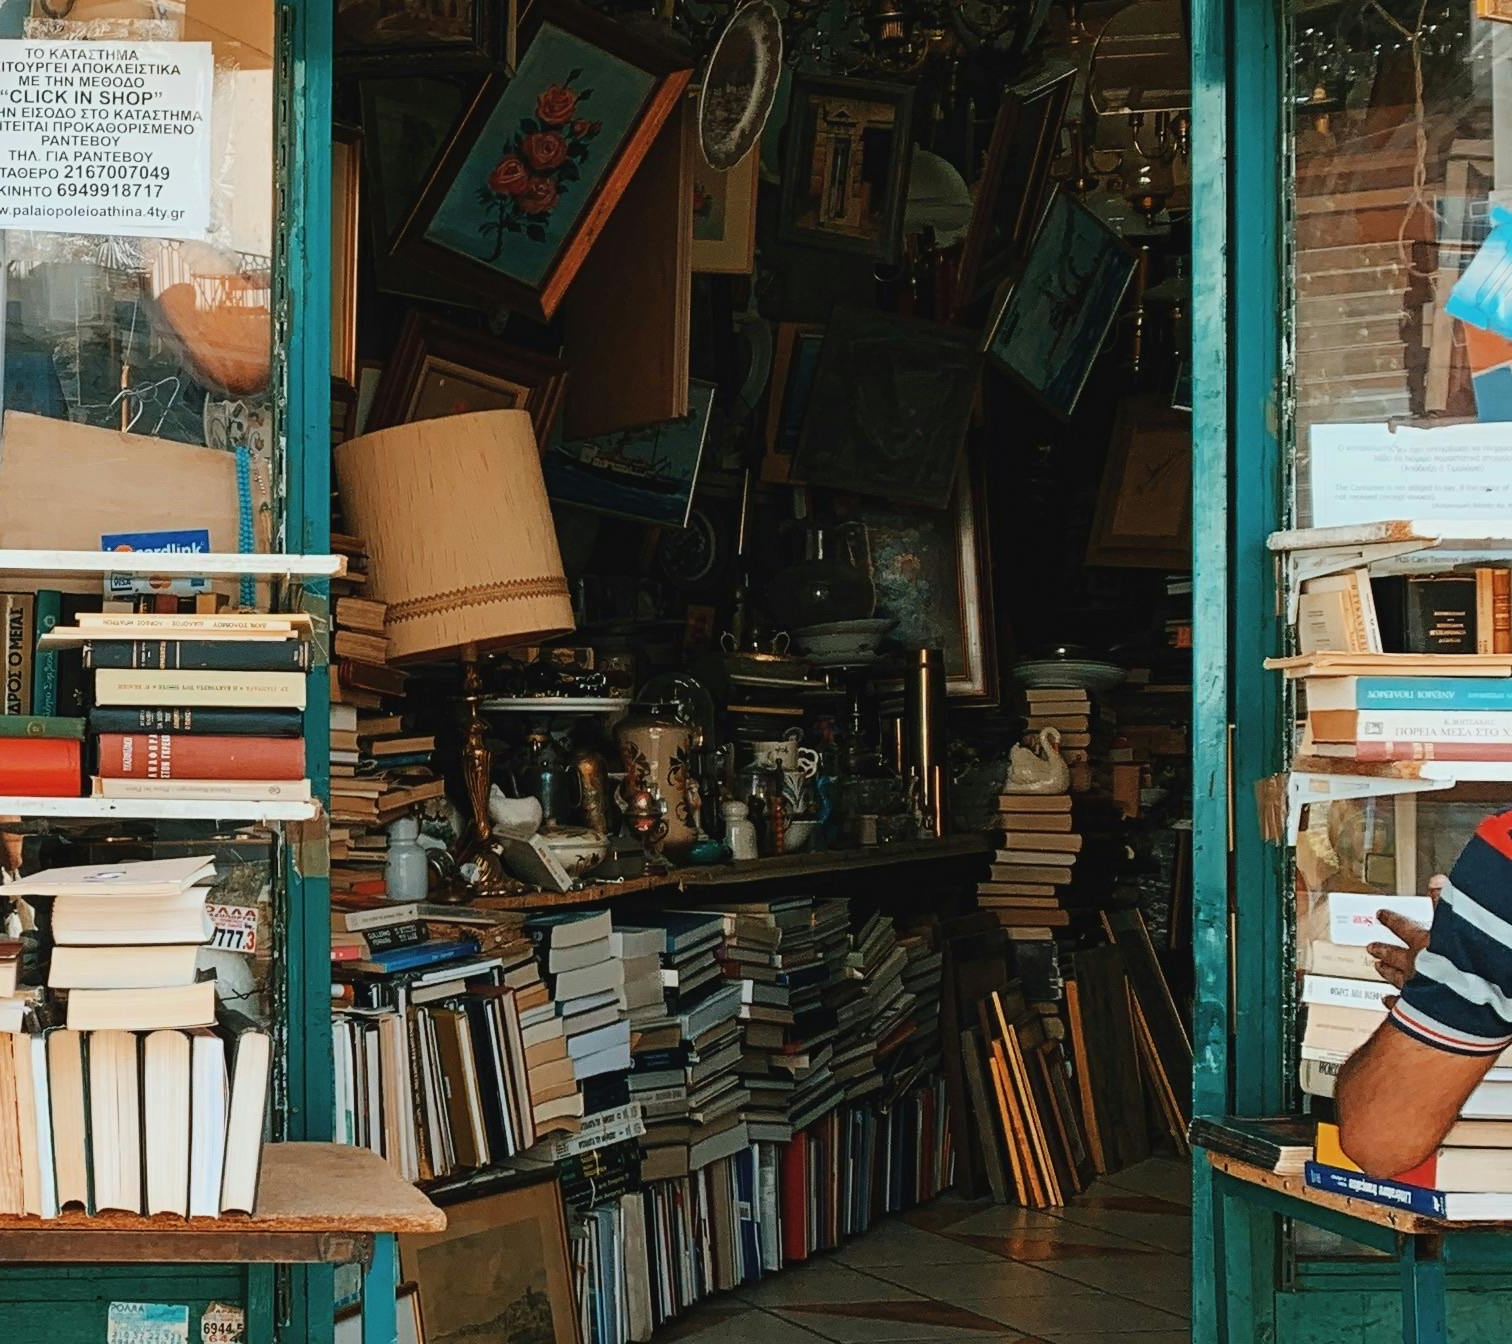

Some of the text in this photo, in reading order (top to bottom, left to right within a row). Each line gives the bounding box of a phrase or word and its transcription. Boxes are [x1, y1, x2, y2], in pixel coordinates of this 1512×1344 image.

[24, 47, 139, 61] ΤΟ ΚΑΤΑΣΤΗΜΑ
[71, 63, 181, 76] ΑΠΟΚΛΕΙΣΤΙΚΑ
[18, 75, 145, 89] ΜΕ ΤΗΝ ΜΕΘΟΔΟ
[74, 90, 93, 105] IN
[21, 107, 76, 119] ΕΙΣΟΔΟ
[80, 108, 109, 120] ΣΤΟ
[114, 109, 203, 122] ΚΑΤΑΣΤΗΜΑ
[52, 121, 195, 135] ΠΡΟΚΑΘΟΡΙΣΜΕΝΟ
[41, 135, 121, 148] ΡΑΝΤΕΒΟΥ
[46, 150, 70, 163] ΓΙΑ
[74, 151, 153, 164] ΡΑΝΤΕΒΟΥ
[64, 164, 170, 181] 2167007049
[57, 182, 164, 199] 6949918717
